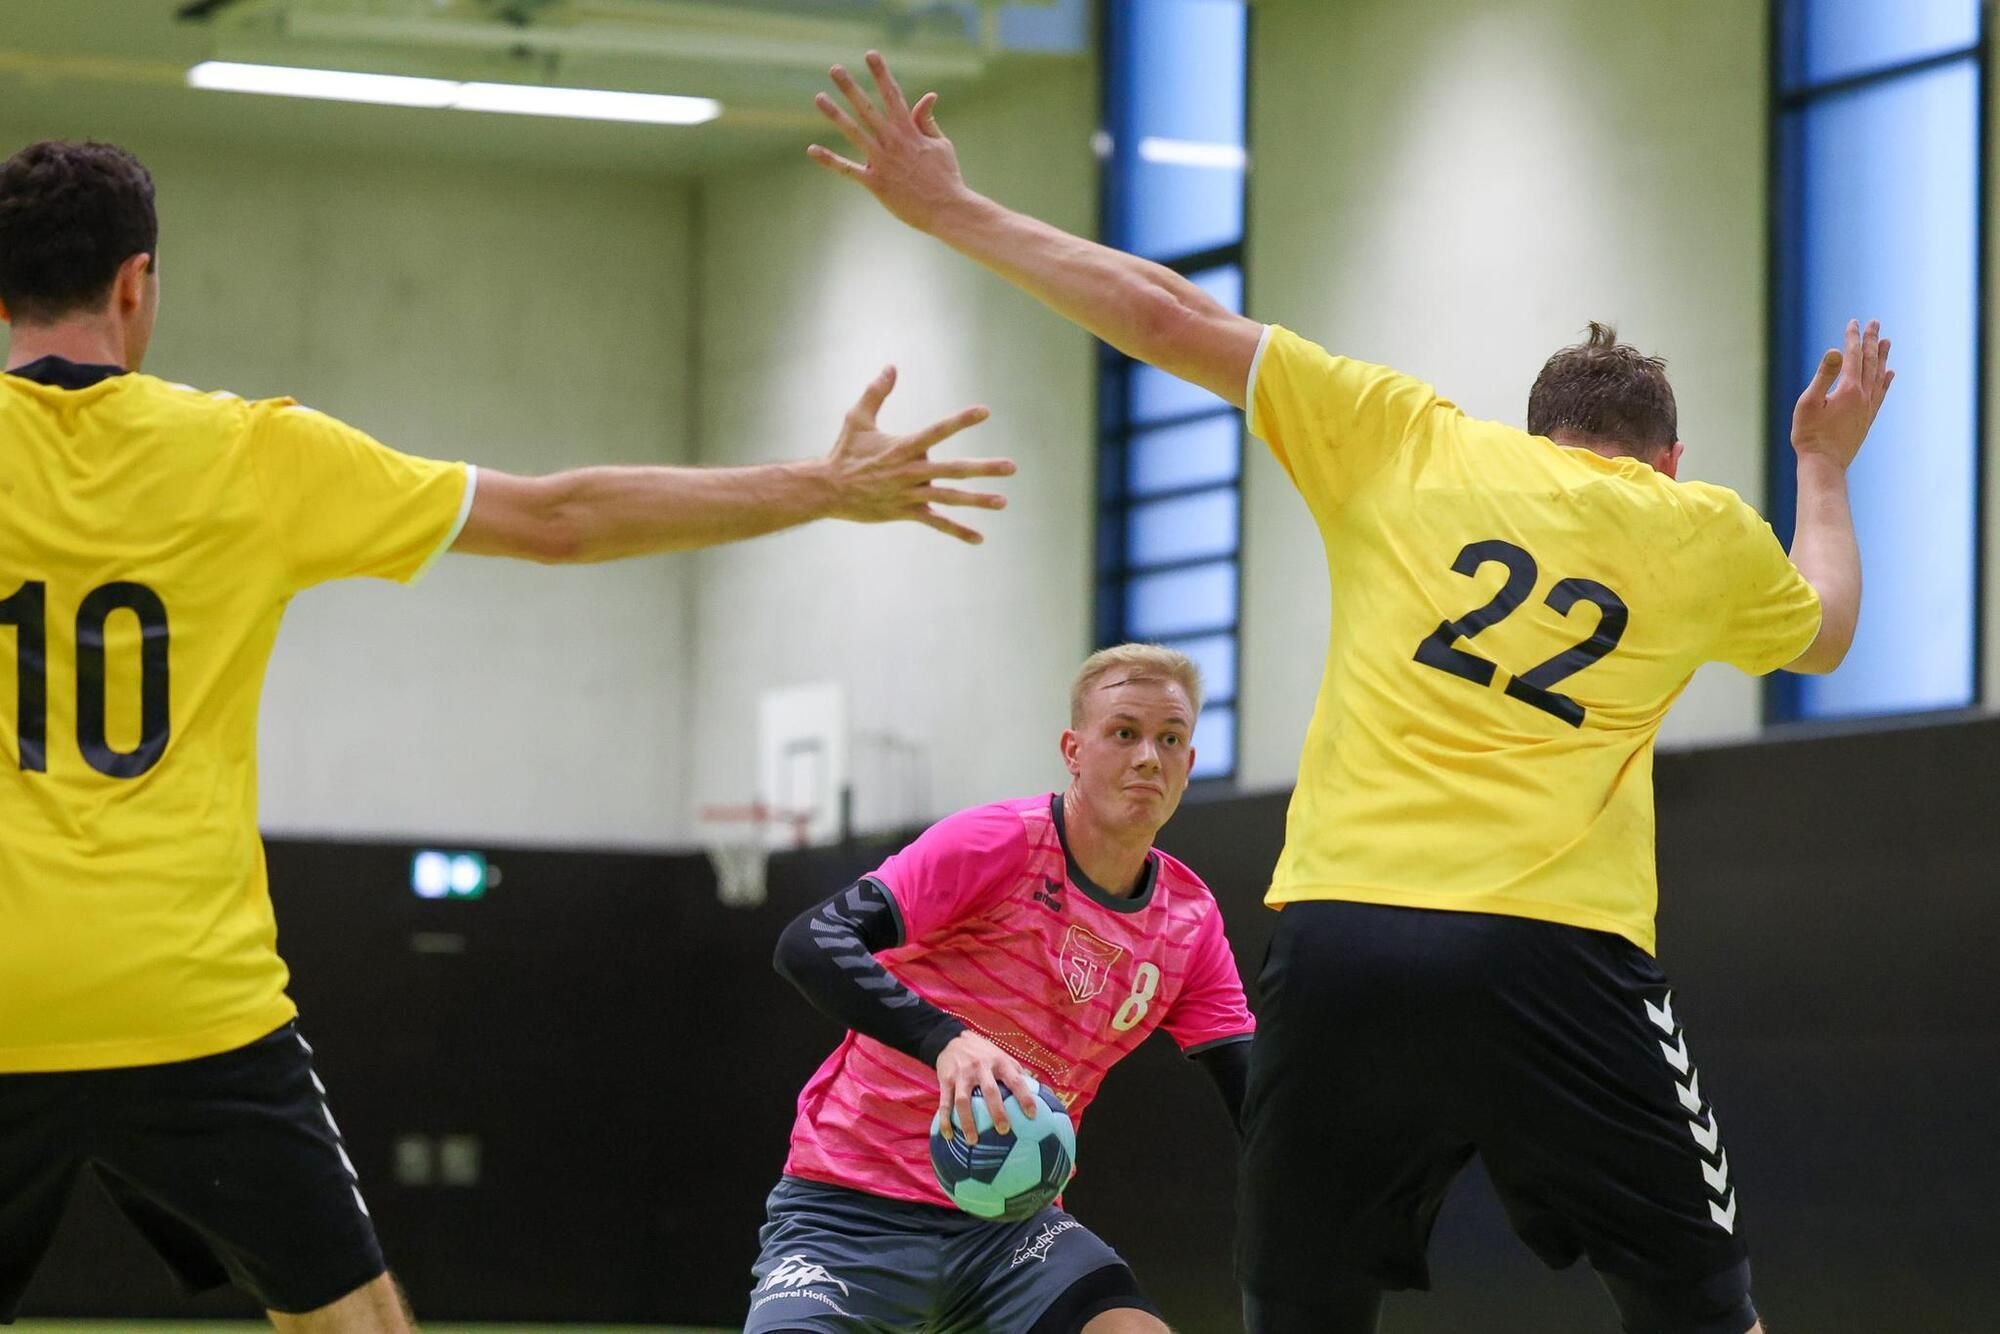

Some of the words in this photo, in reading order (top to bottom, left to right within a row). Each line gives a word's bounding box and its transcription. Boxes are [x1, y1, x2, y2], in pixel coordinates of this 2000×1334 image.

[0, 580, 170, 780] 10
[1411, 539, 1629, 729] 22
[1112, 961, 1160, 1031] 8
